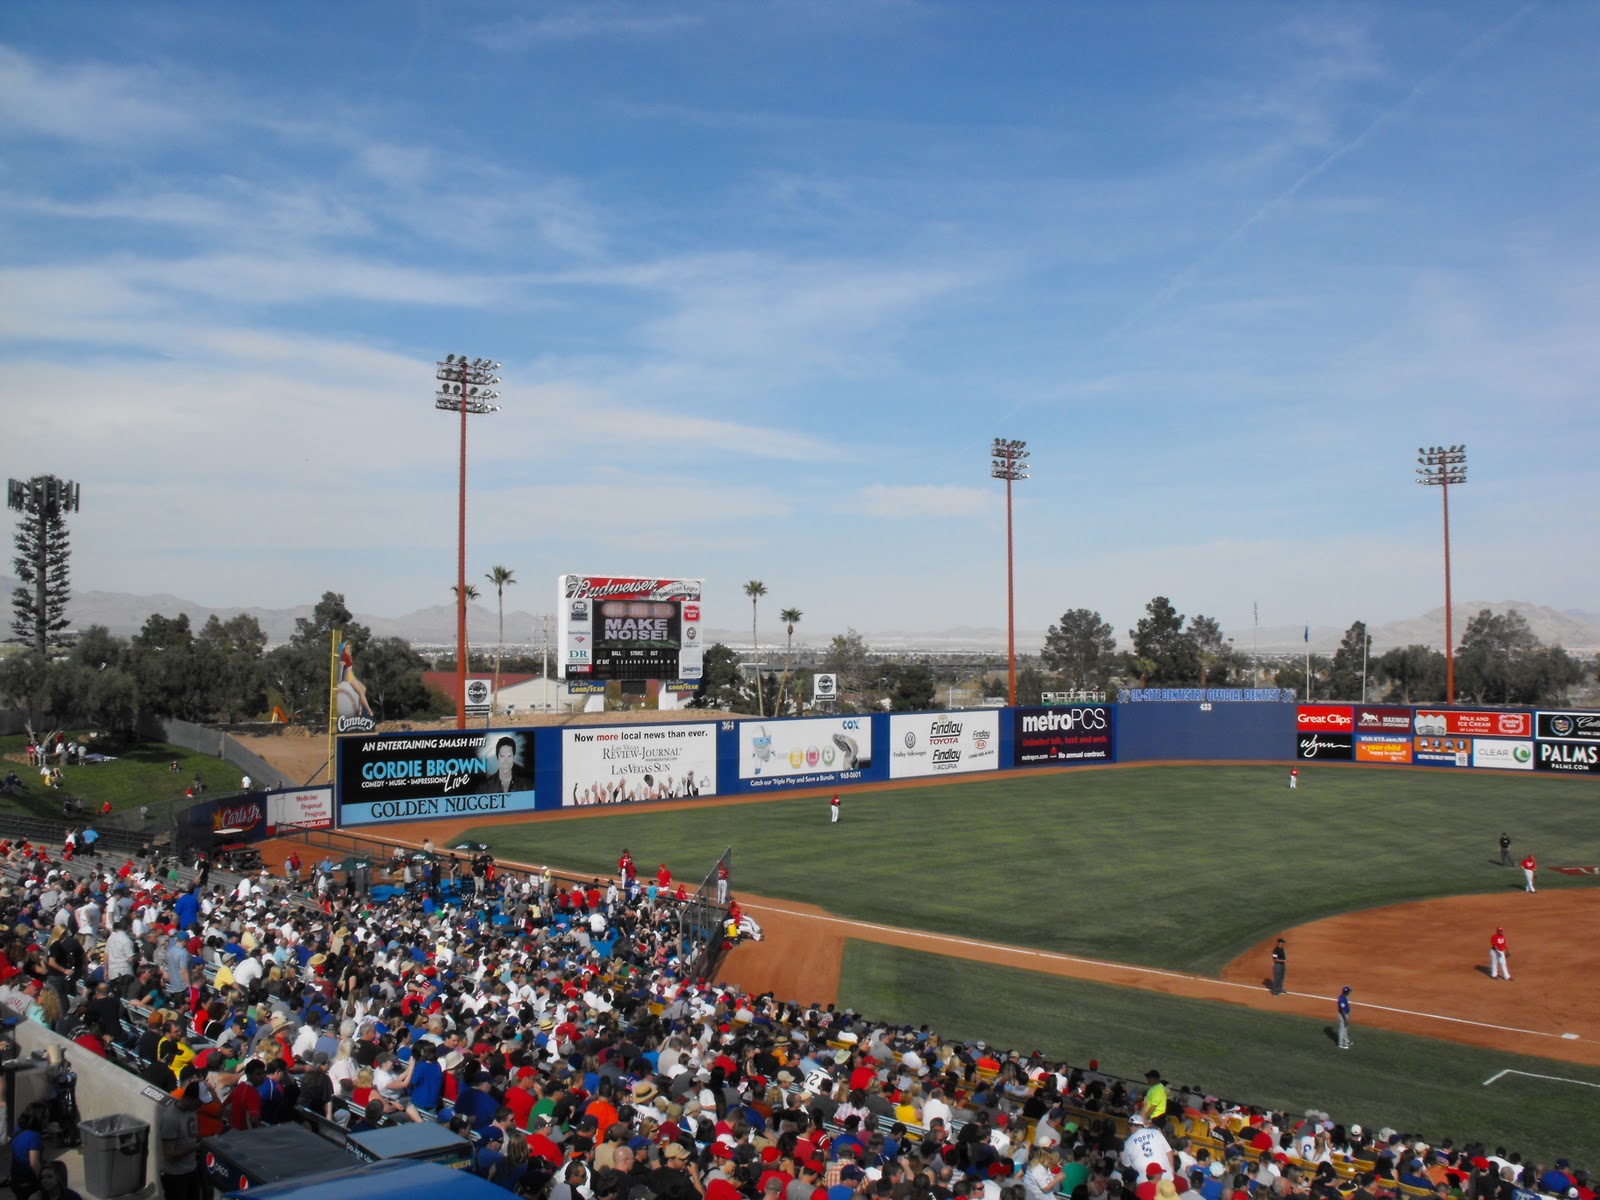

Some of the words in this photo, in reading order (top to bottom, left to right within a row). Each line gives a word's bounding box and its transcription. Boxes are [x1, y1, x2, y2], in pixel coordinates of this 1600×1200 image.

[567, 578, 658, 599] Budweiser
[604, 618, 668, 630] MAKE
[604, 630, 668, 640] NOISE!
[569, 650, 587, 658] DR
[571, 684, 605, 693] GOODYEAR
[668, 683, 699, 691] GOODYEAR
[1130, 688, 1161, 701] ON-SITE
[1161, 688, 1206, 701] DENTISTRY
[1207, 688, 1243, 701] OFFICIAL
[1244, 688, 1280, 701] DENTIST
[1200, 703, 1212, 711] 433
[338, 715, 375, 732] Cannery
[721, 721, 734, 731] 364
[1022, 708, 1105, 732] metroPCS
[1298, 714, 1326, 723] Great
[1327, 714, 1351, 725] Clips
[930, 721, 963, 736] Findlay
[574, 733, 594, 742] Now
[596, 734, 619, 742] more
[621, 731, 641, 740] local
[668, 731, 686, 739] than
[688, 729, 708, 737] ever.
[362, 742, 376, 752] AN
[377, 739, 437, 751] ENTERTAINING
[439, 738, 467, 748] SMASH
[469, 737, 486, 747] HIT!
[932, 749, 961, 763] Findlay
[1479, 748, 1509, 756] CLEAR
[1541, 744, 1598, 764] PALMS
[362, 759, 422, 780] GORDIE
[427, 758, 487, 776] BROWN
[411, 777, 447, 785] IMPRESSIONS
[444, 770, 470, 792] Live
[301, 802, 322, 810] Disposal
[371, 799, 439, 818] GOLDEN
[445, 794, 508, 812] NUGGET
[247, 804, 262, 822] Jr.
[304, 810, 327, 818] Program
[1133, 1133, 1154, 1144] POPPI
[1141, 1141, 1153, 1158] 5
[215, 1162, 229, 1178] pepsi
